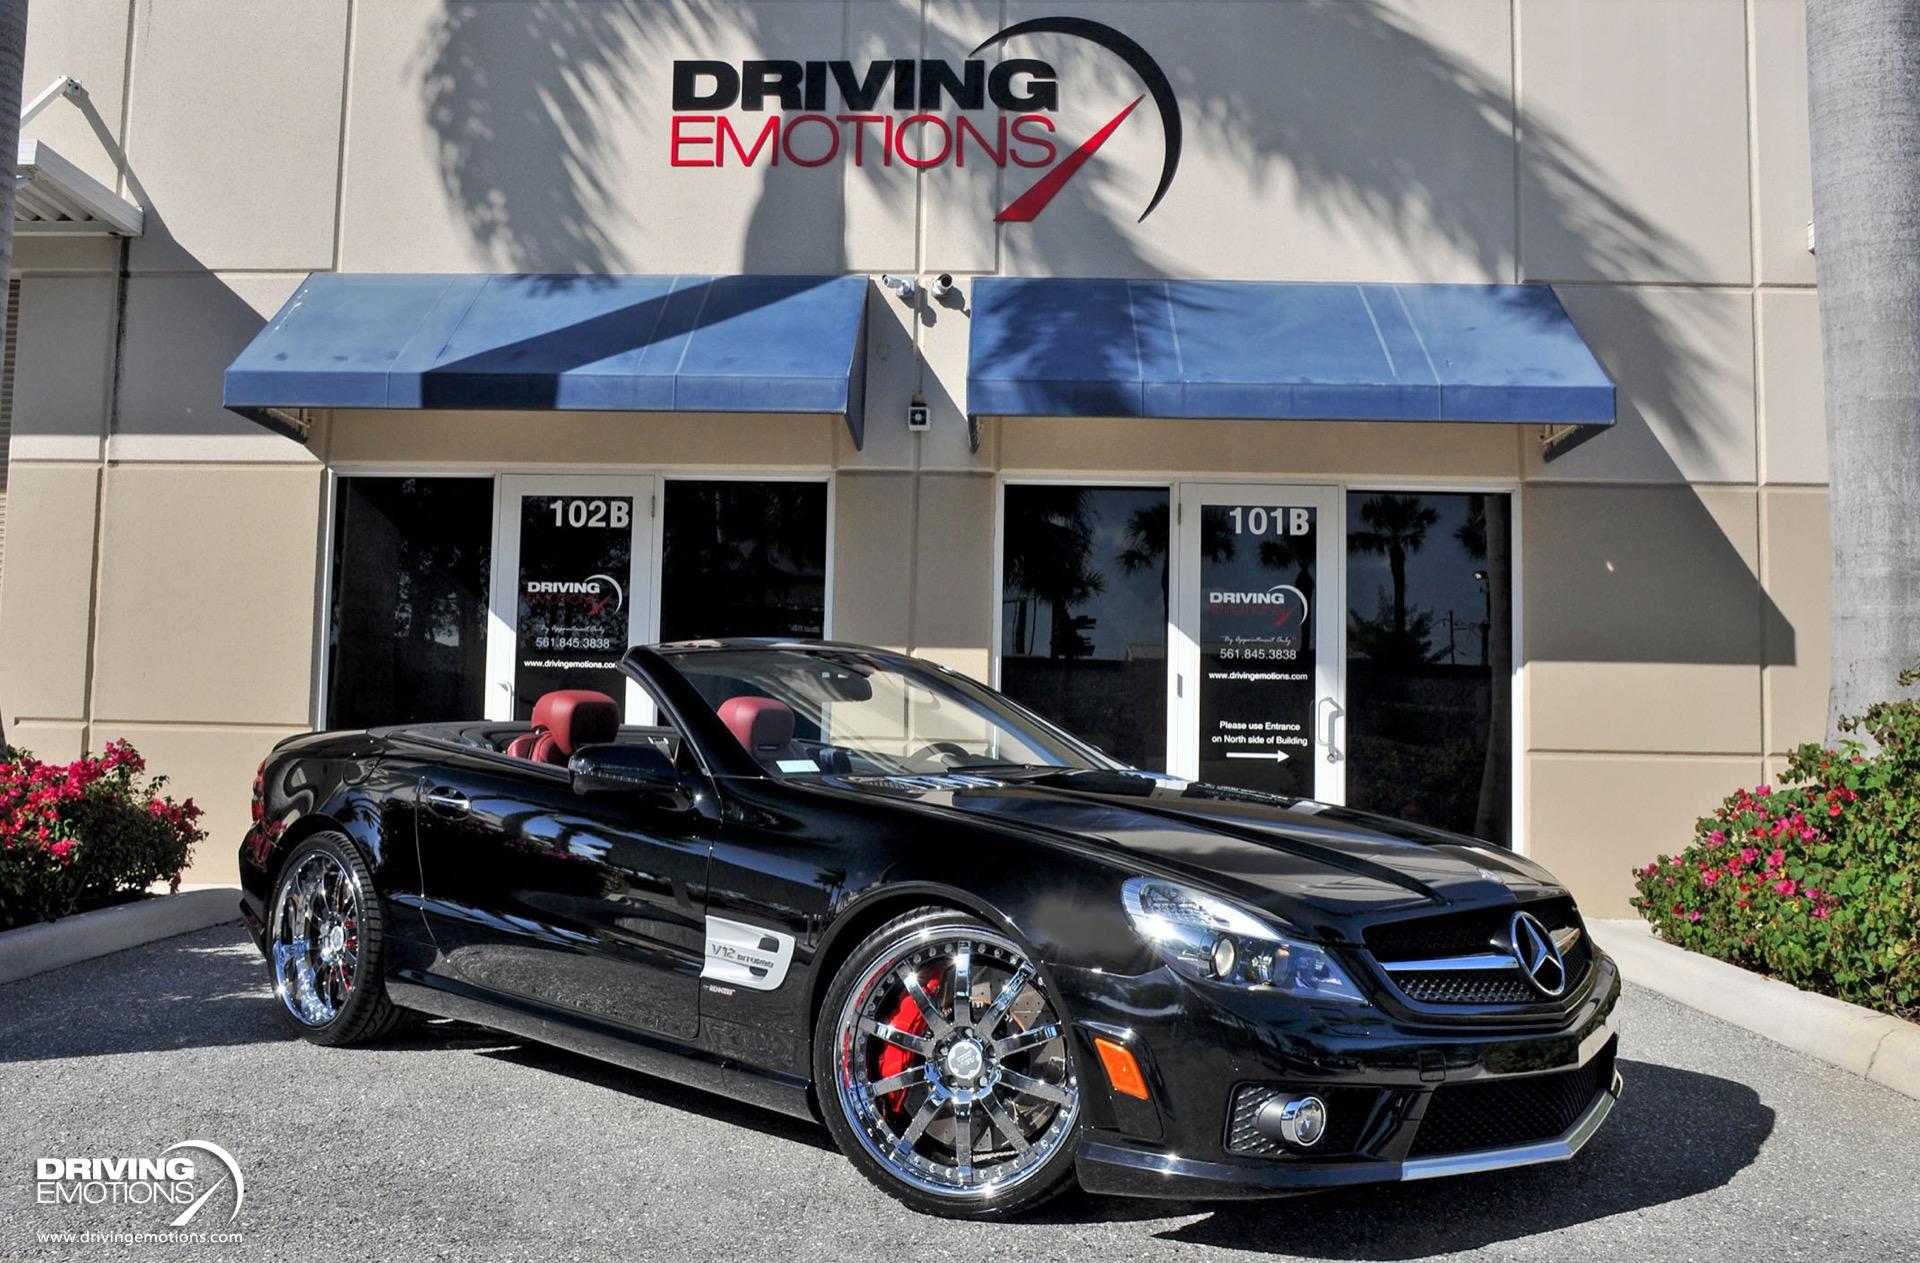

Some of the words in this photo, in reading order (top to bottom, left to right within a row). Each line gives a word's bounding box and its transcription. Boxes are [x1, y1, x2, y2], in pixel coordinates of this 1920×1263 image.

[672, 58, 1058, 112] DRIVING
[670, 114, 1057, 169] EMOTIONS
[550, 499, 629, 528] 102B
[1229, 507, 1310, 536] 101B
[527, 581, 600, 594] DRIVING
[1209, 592, 1285, 605] DRIVING
[535, 637, 610, 649] 561.845.3838
[1219, 648, 1297, 660] 561.845.3838
[1208, 671, 1308, 682] www.drivingemotions.com
[1219, 720, 1247, 730] Please
[1248, 722, 1264, 730] use
[1265, 721, 1301, 731] Entrance
[1211, 735, 1222, 743] on
[1223, 734, 1247, 744] North
[1247, 735, 1265, 744] side
[1266, 735, 1274, 744] of
[1276, 735, 1308, 747] Building
[712, 943, 736, 958] V12
